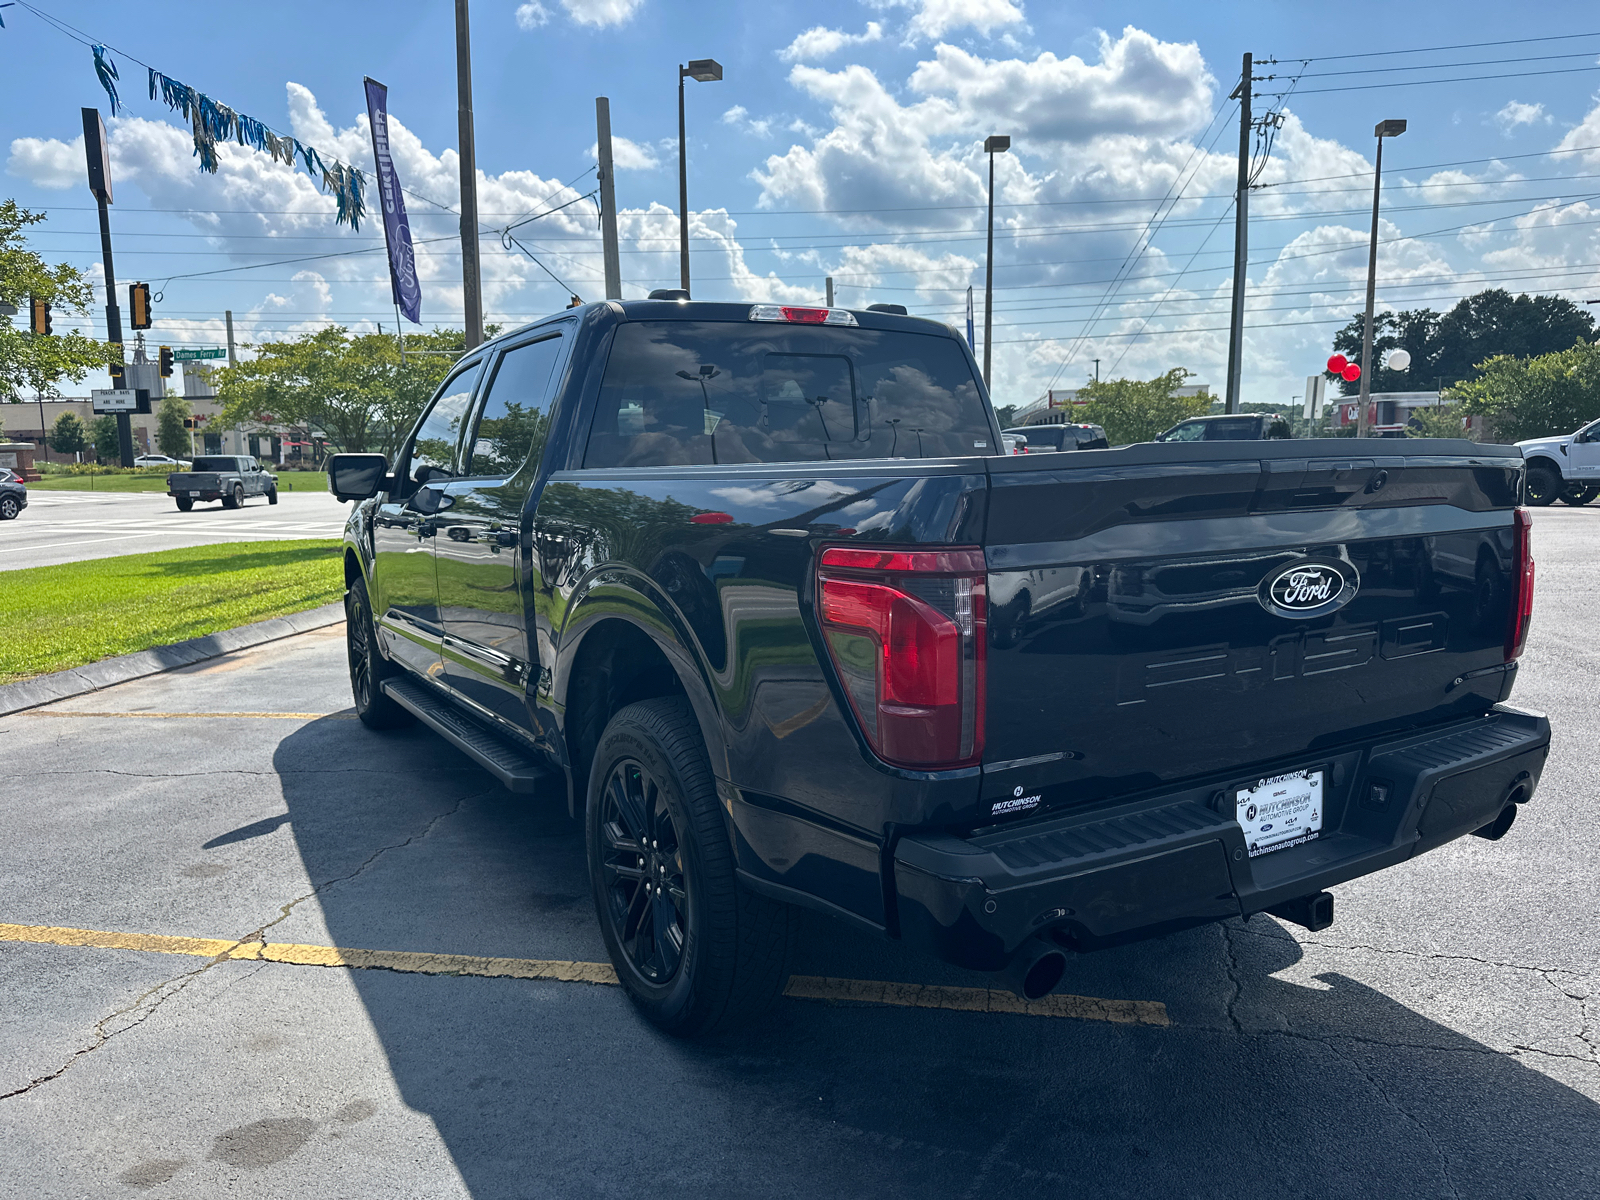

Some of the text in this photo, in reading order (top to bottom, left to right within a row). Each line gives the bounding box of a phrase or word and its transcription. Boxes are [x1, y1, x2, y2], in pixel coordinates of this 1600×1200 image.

[176, 351, 197, 359] Dames
[200, 350, 216, 359] Ferry
[1284, 571, 1333, 604] Ford
[991, 794, 1042, 811] HUTCHINSON
[991, 802, 1039, 816] AUTOMOTIVE GROUP
[1259, 792, 1312, 816] HUTCHINSON
[1259, 808, 1293, 823] AUTOMOTIVE
[1292, 803, 1310, 815] GROUP
